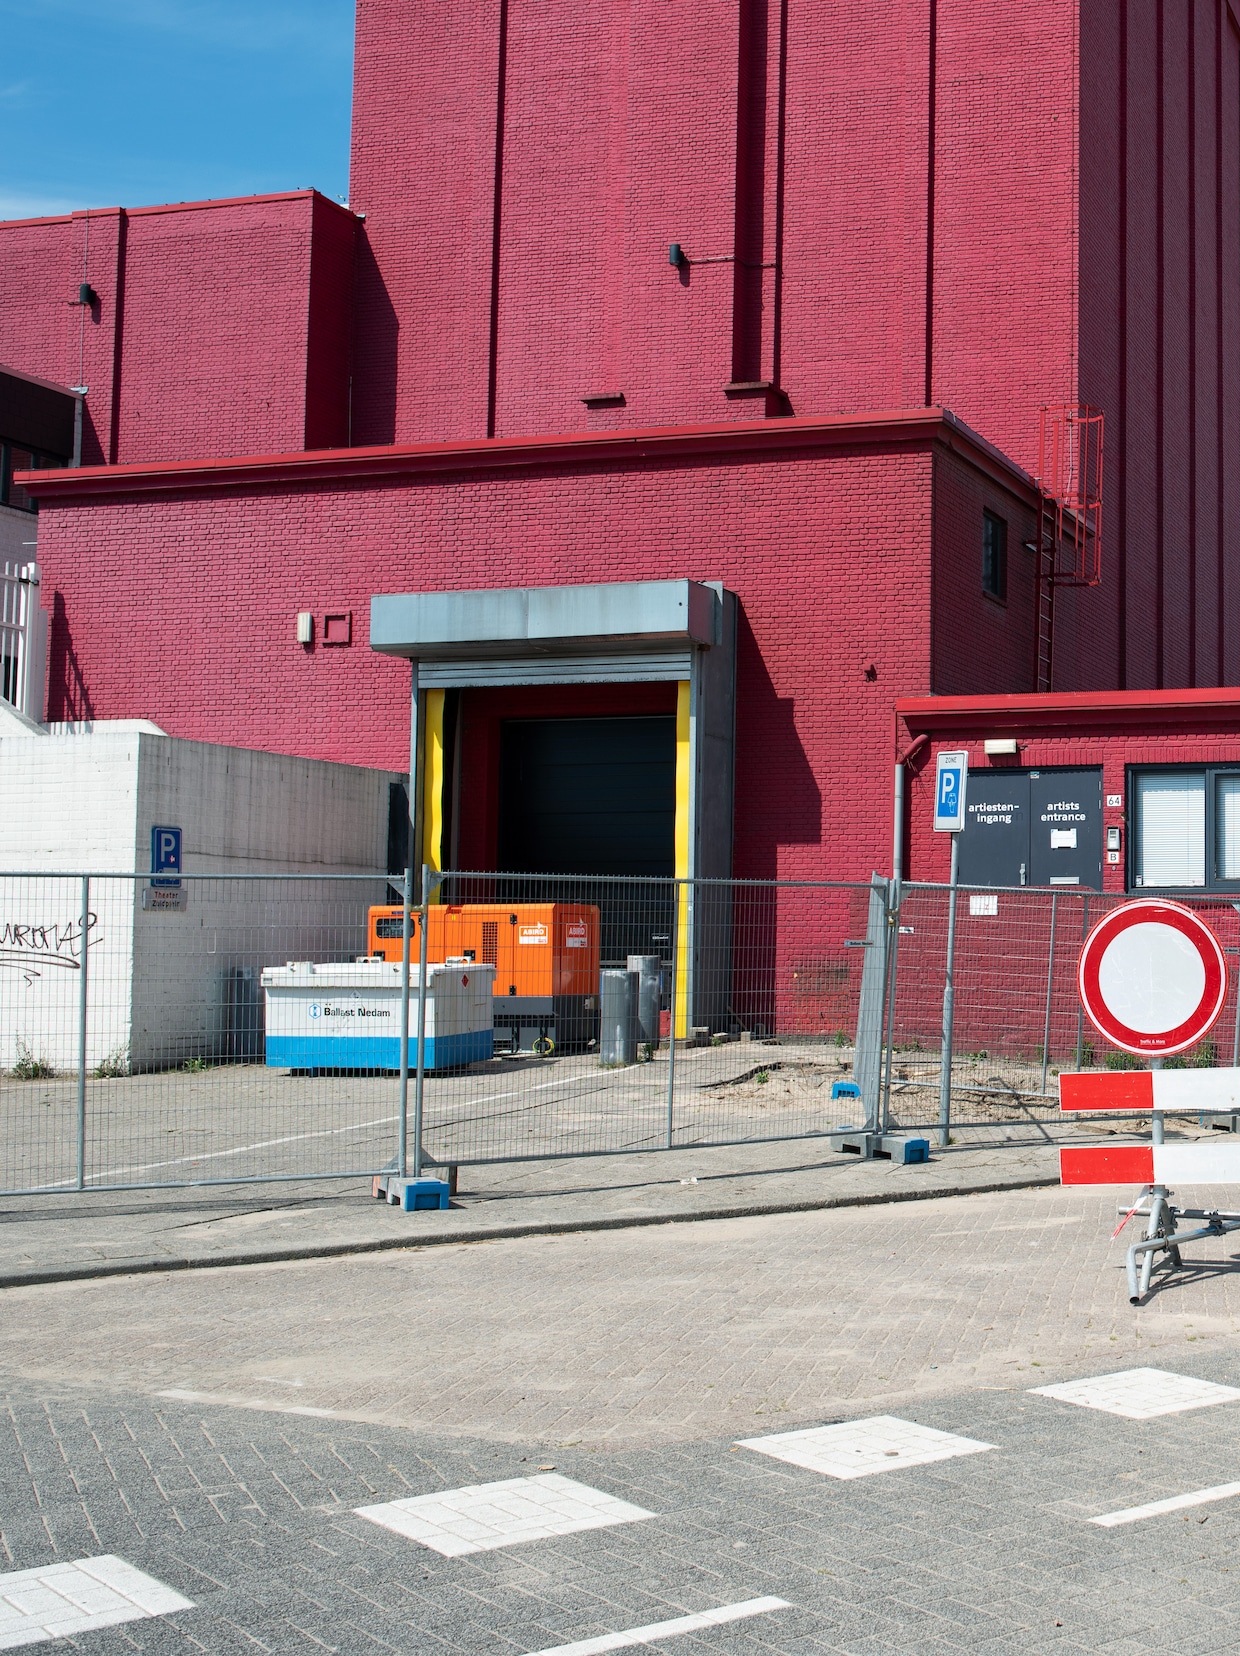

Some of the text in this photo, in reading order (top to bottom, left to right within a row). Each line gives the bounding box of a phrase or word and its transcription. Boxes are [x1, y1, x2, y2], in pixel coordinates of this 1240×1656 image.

[1047, 801, 1080, 811] artists
[1108, 797, 1120, 806] 64
[968, 802, 1020, 812] artiesten-
[977, 813, 1012, 824] ingang
[1040, 812, 1086, 821] entrance
[1110, 853, 1117, 861] B
[357, 1008, 391, 1017] Nedam
